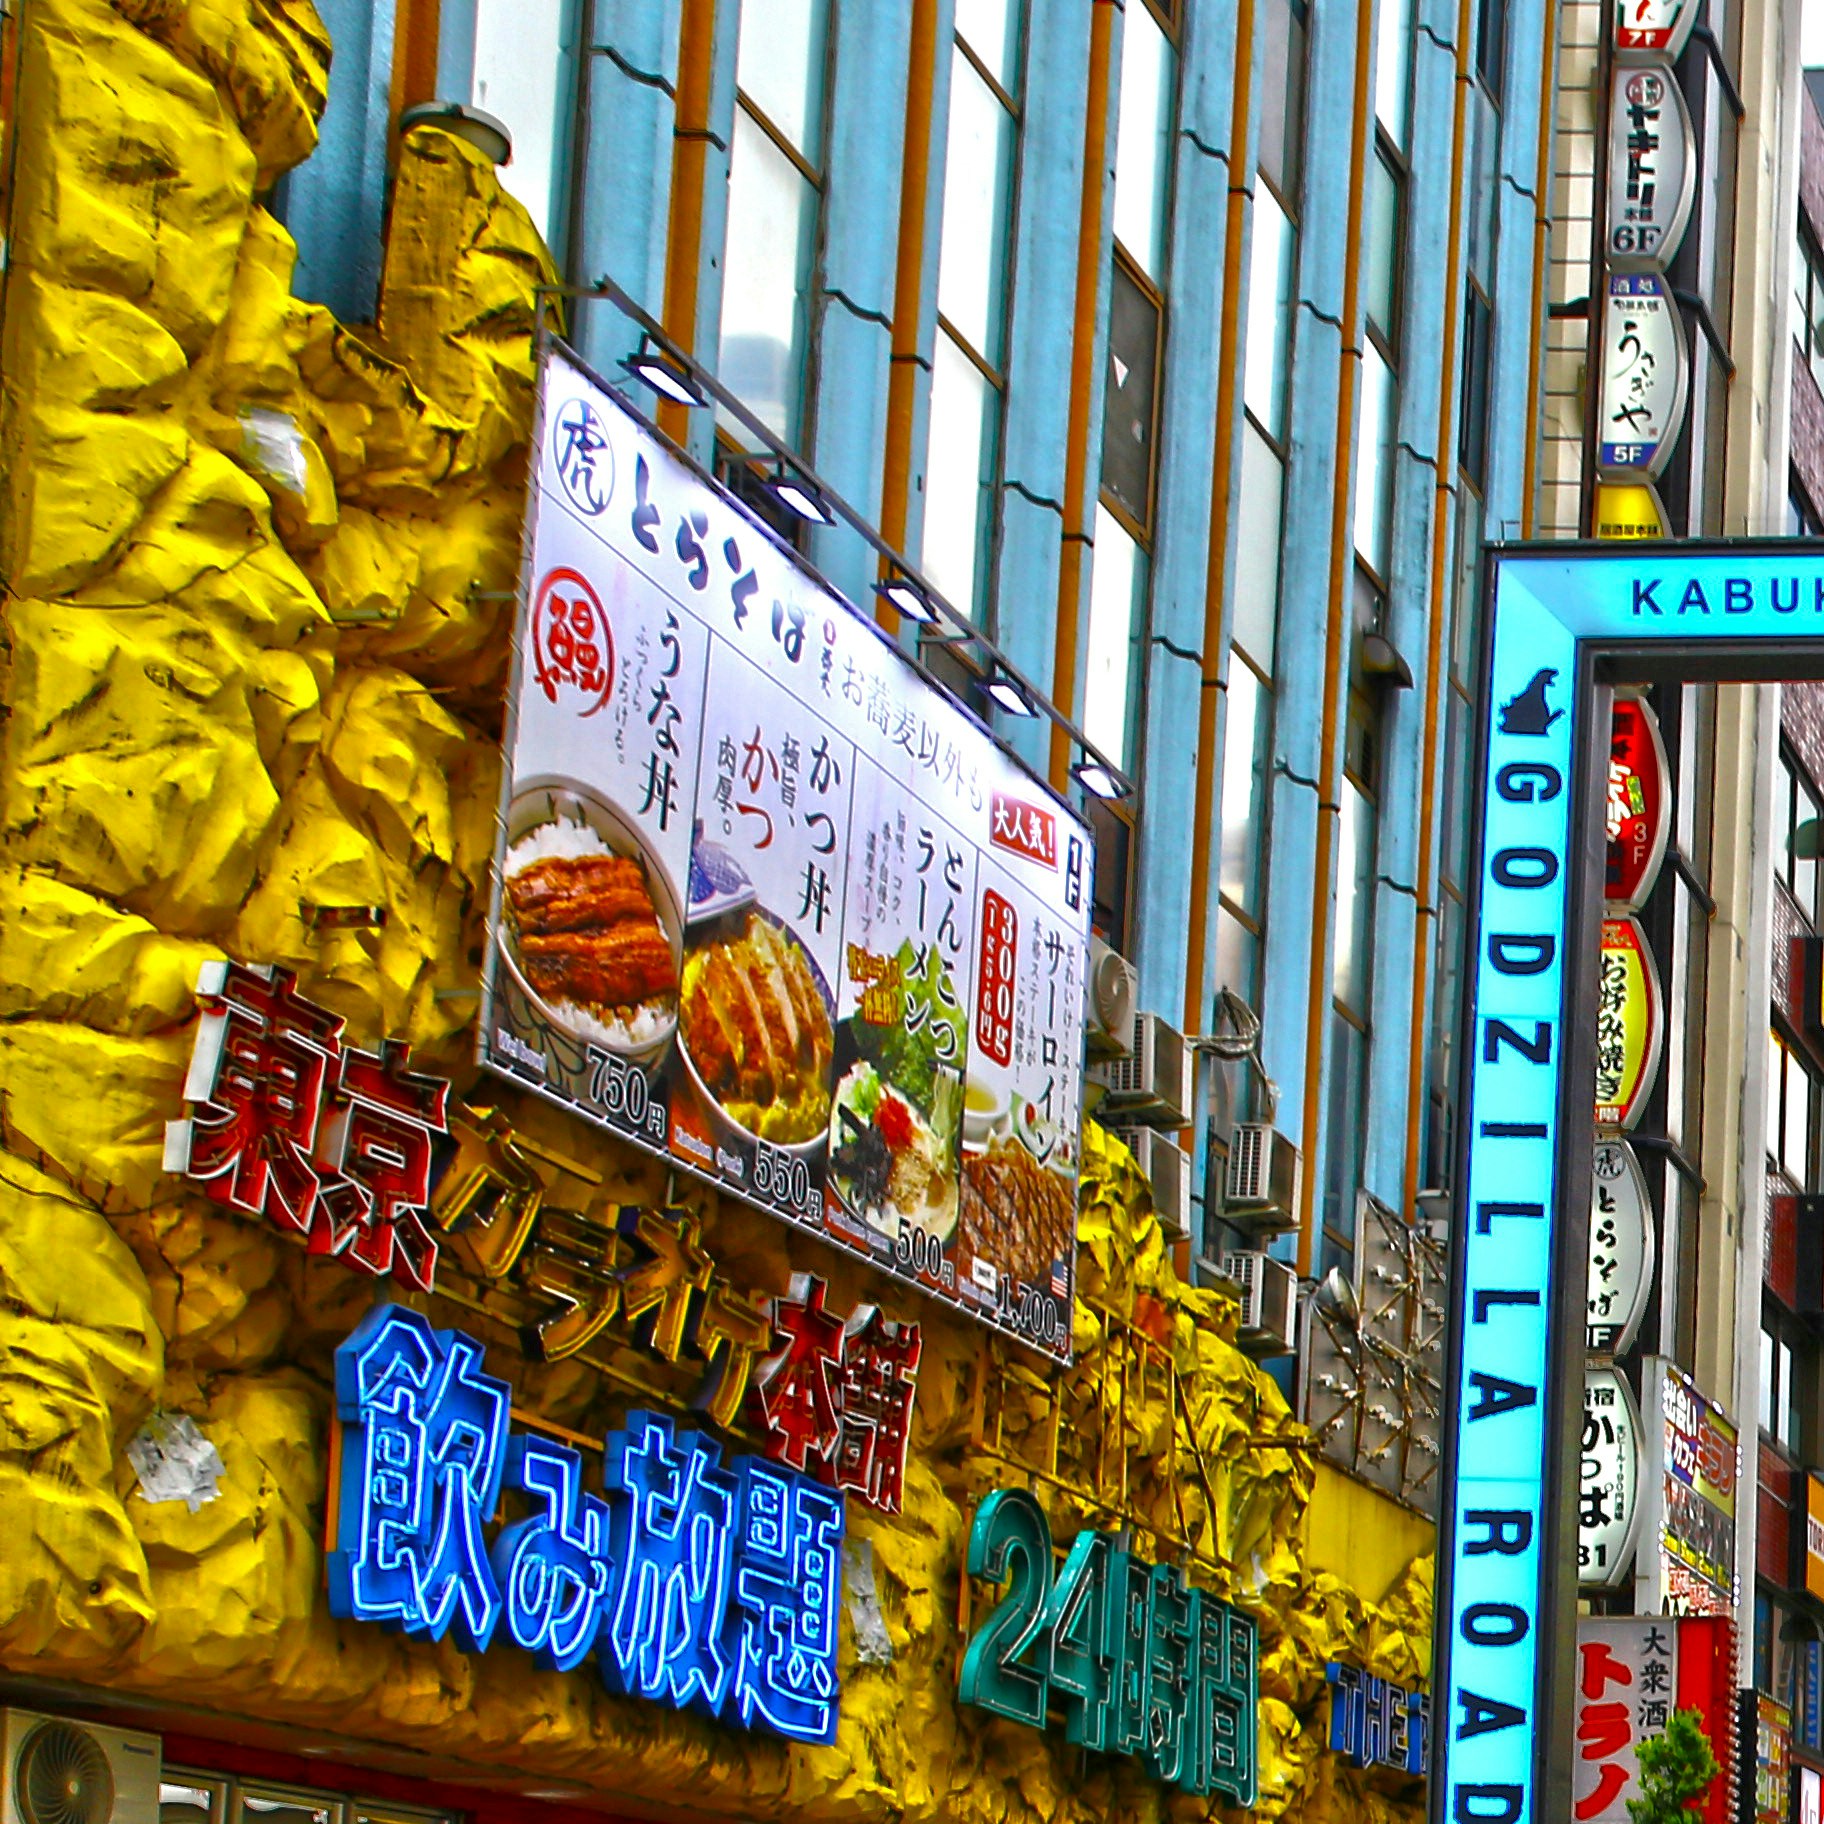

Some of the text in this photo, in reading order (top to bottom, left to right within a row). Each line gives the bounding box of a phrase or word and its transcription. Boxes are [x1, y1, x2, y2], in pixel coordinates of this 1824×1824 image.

[1627, 31, 1657, 46] 7F
[1626, 104, 1660, 207] ヤキトリ
[1613, 226, 1662, 253] 6F
[1614, 447, 1643, 464] 5F
[632, 452, 806, 664] とらそば
[638, 607, 684, 832] うな丼
[737, 724, 779, 851] かつ
[798, 734, 841, 934] かつ丼
[904, 826, 935, 1033] ラーメン
[930, 840, 964, 1061] とんこつ
[994, 907, 1015, 1060] 300g
[586, 1043, 667, 1139] 750円
[1036, 929, 1067, 1168] サーロイン
[1469, 762, 1563, 1423] GODZILLA
[754, 1139, 823, 1221] 550円
[896, 1216, 955, 1288] 500円
[1588, 1184, 1618, 1317] とらそば
[330, 1303, 850, 1748] 飲み放題
[960, 1488, 1259, 1808] 24時間
